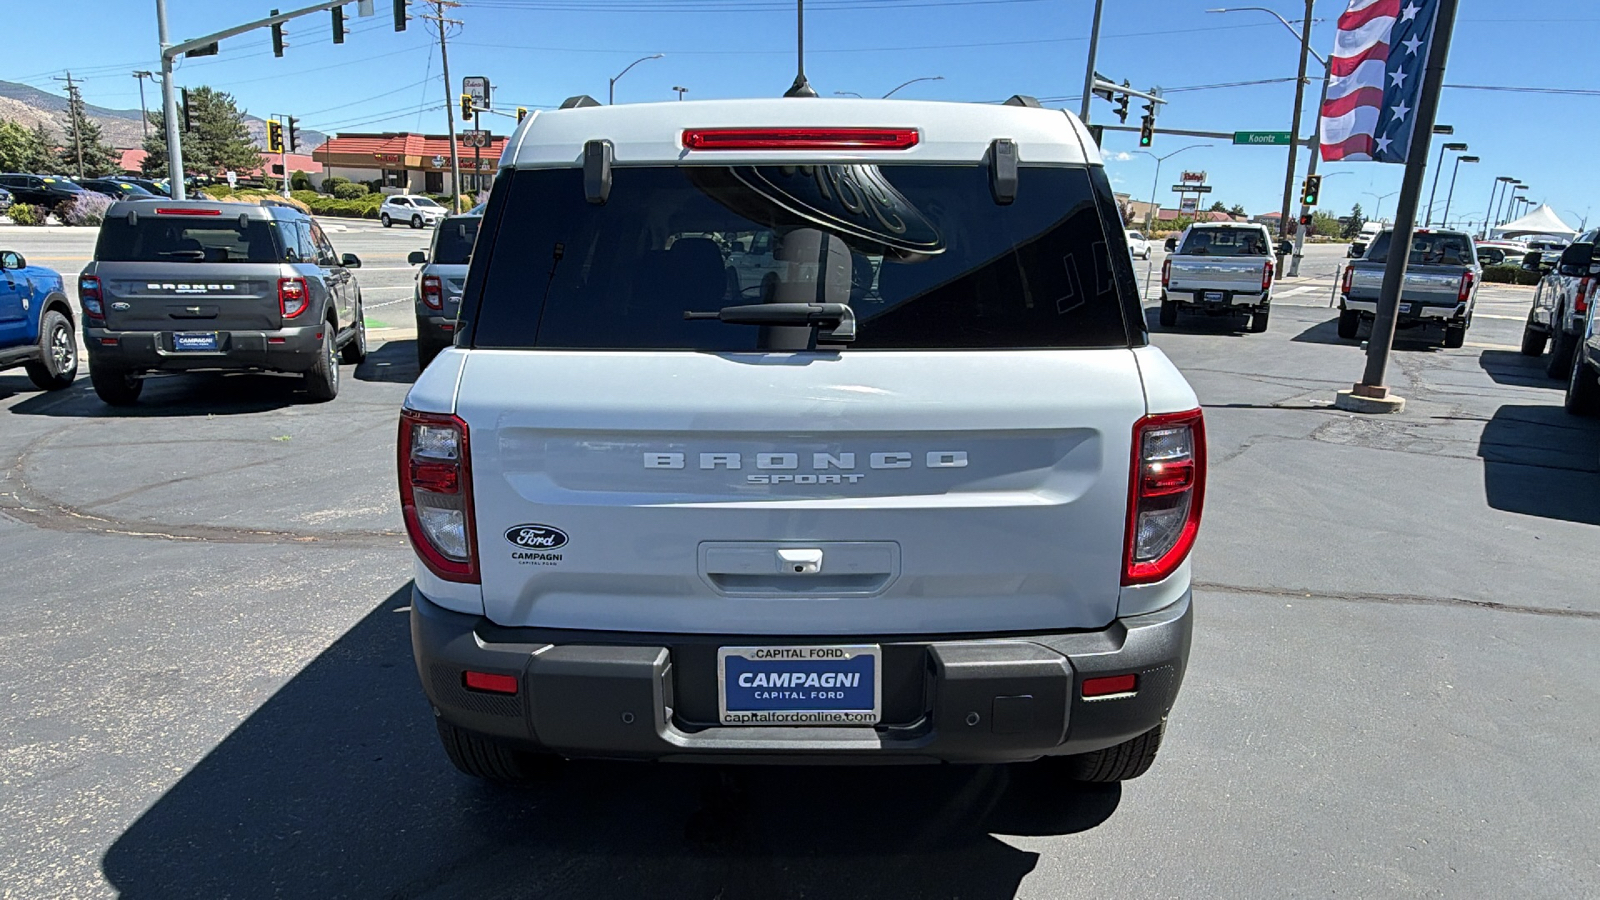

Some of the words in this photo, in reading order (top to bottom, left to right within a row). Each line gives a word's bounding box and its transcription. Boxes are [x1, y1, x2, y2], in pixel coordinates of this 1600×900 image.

[1248, 133, 1276, 143] Koontz
[643, 451, 968, 470] BRONCO
[747, 473, 865, 484] SPORT
[517, 529, 555, 545] Ford
[512, 552, 562, 560] CAMPAGNI
[756, 649, 806, 658] CAPITAL
[809, 648, 844, 657] FORD
[738, 672, 861, 688] CAMPAGNI
[754, 691, 807, 699] CAPITAL
[810, 691, 845, 699] FORD
[724, 712, 877, 724] capitalfordonline.com
